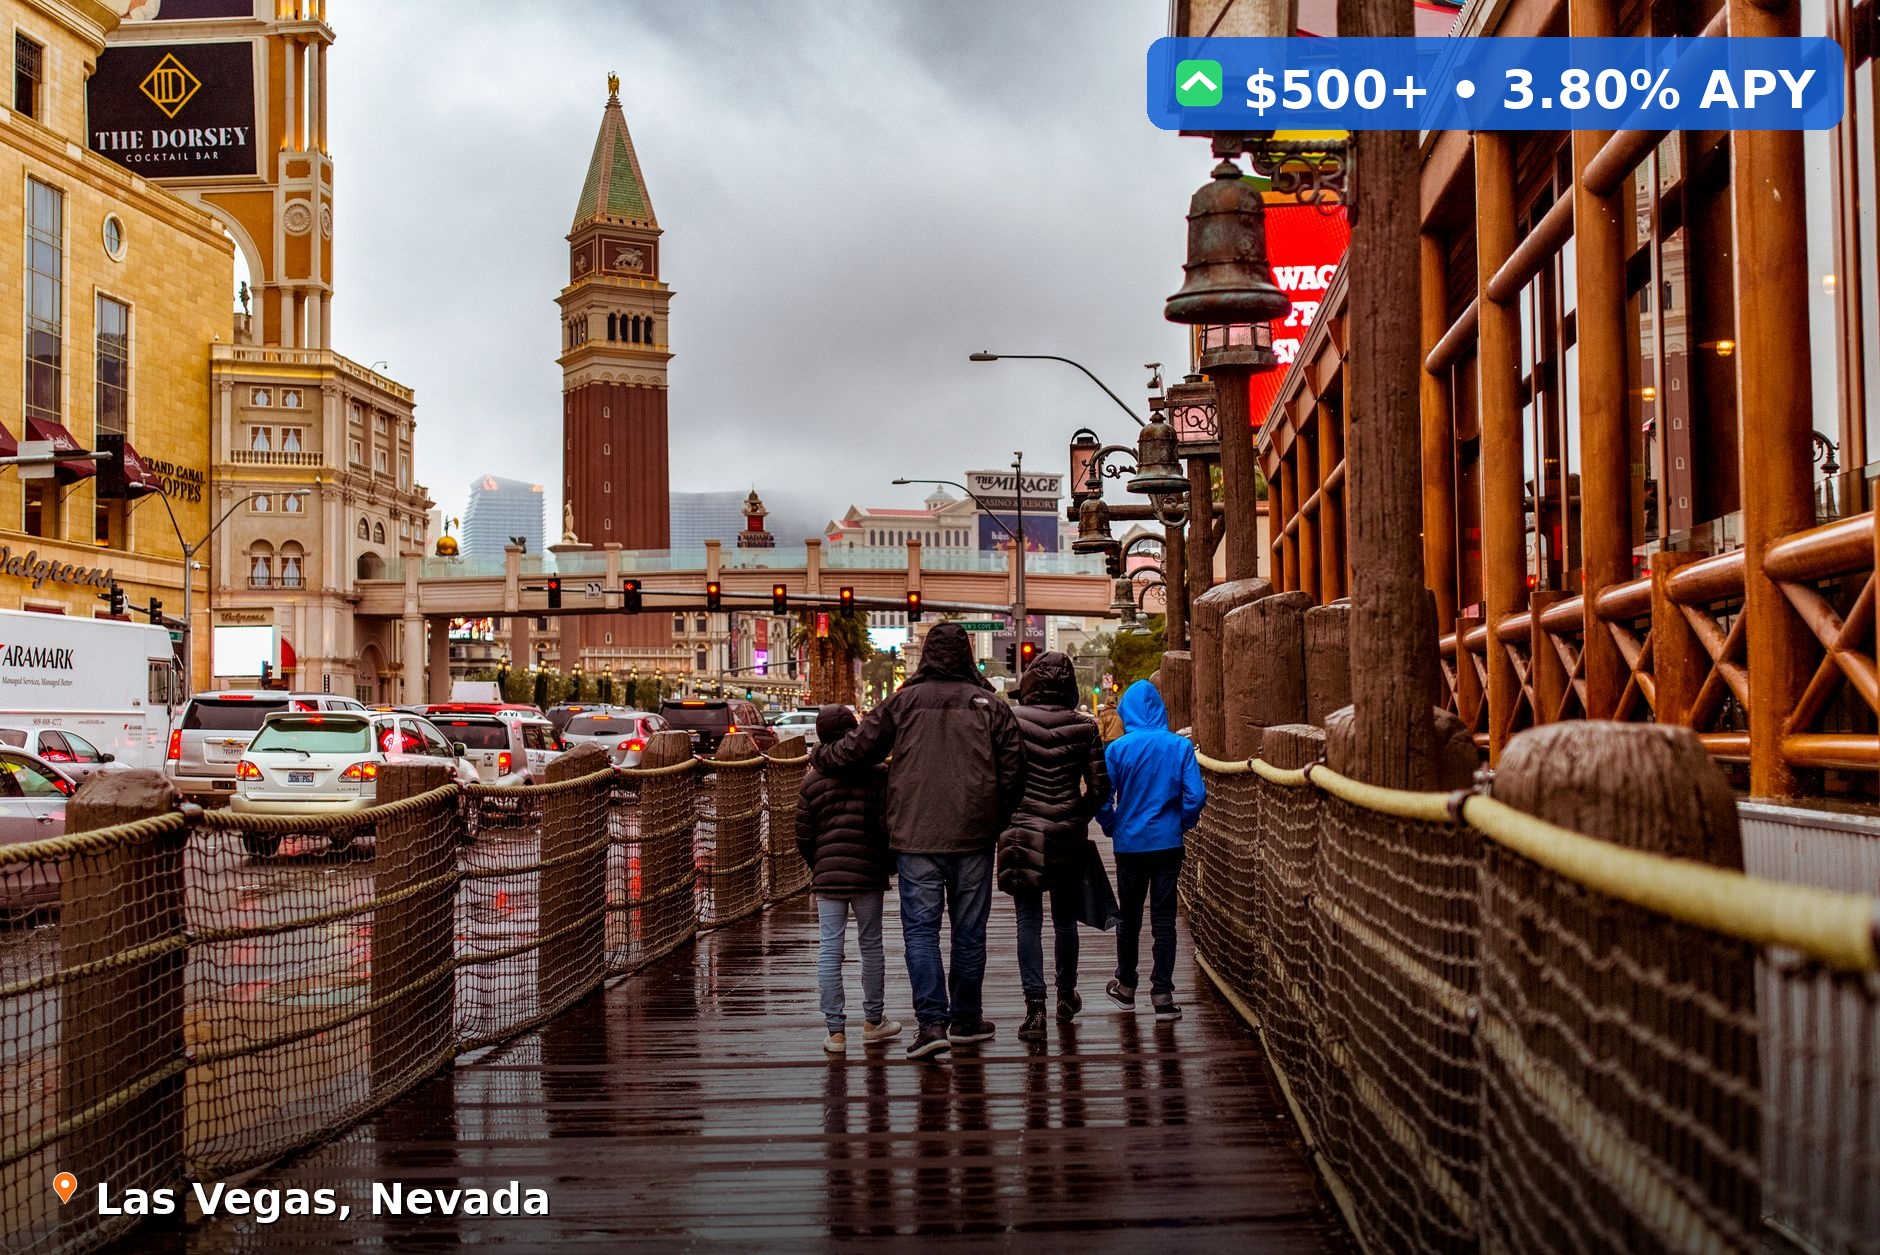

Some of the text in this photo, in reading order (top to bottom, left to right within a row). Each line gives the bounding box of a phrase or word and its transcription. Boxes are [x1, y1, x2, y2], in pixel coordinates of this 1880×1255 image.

[95, 126, 249, 150] THE DORSEY
[125, 151, 219, 163] COCKTAIL BAR
[176, 465, 206, 484] CANAL
[157, 474, 202, 503] OPPES
[975, 475, 1058, 493] THE MIRAGE
[1022, 499, 1057, 509] RESORT
[2, 645, 74, 670] ARAMARK
[498, 710, 518, 718] TAXI
